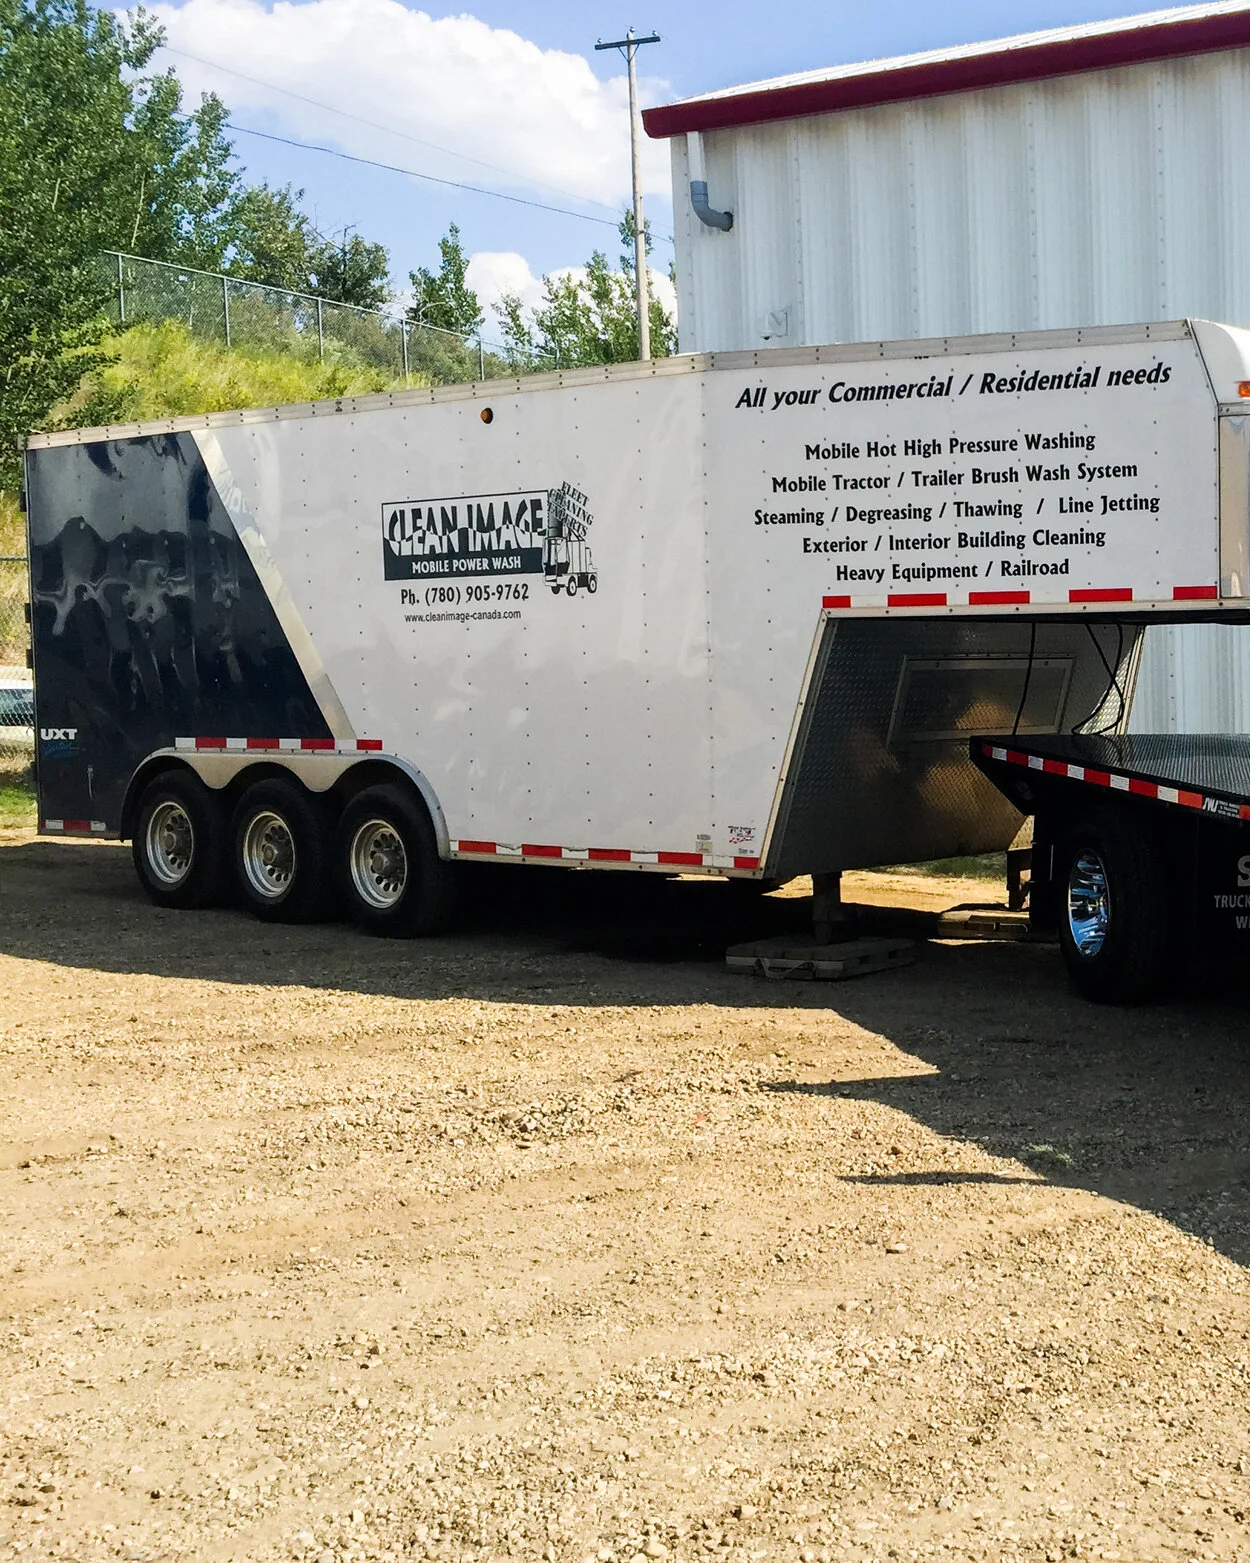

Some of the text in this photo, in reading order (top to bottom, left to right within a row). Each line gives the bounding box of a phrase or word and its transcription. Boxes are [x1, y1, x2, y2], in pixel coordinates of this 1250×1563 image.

[734, 361, 1172, 411] All your Commercial / Residential needs
[804, 430, 1096, 461] Mobile Hot High Pressure Washing
[771, 462, 1138, 493] Mobile Tractor / Trailer Brush Wash System
[561, 481, 588, 507] FLEET
[754, 495, 1161, 527] Steaming / Degreasing / Thawing / Line Jetting
[388, 499, 546, 556] CLEAN IMAGE
[802, 527, 1107, 554] Exterior / Interior Building Cleaning
[412, 556, 522, 574] MOBILE POWER WASH
[836, 558, 1070, 584] Heavy Equipment / Railroad
[401, 583, 529, 606] Ph. (780) 905-9762
[404, 609, 522, 623] www.cleanimage-canada.com
[40, 728, 78, 740] UXT
